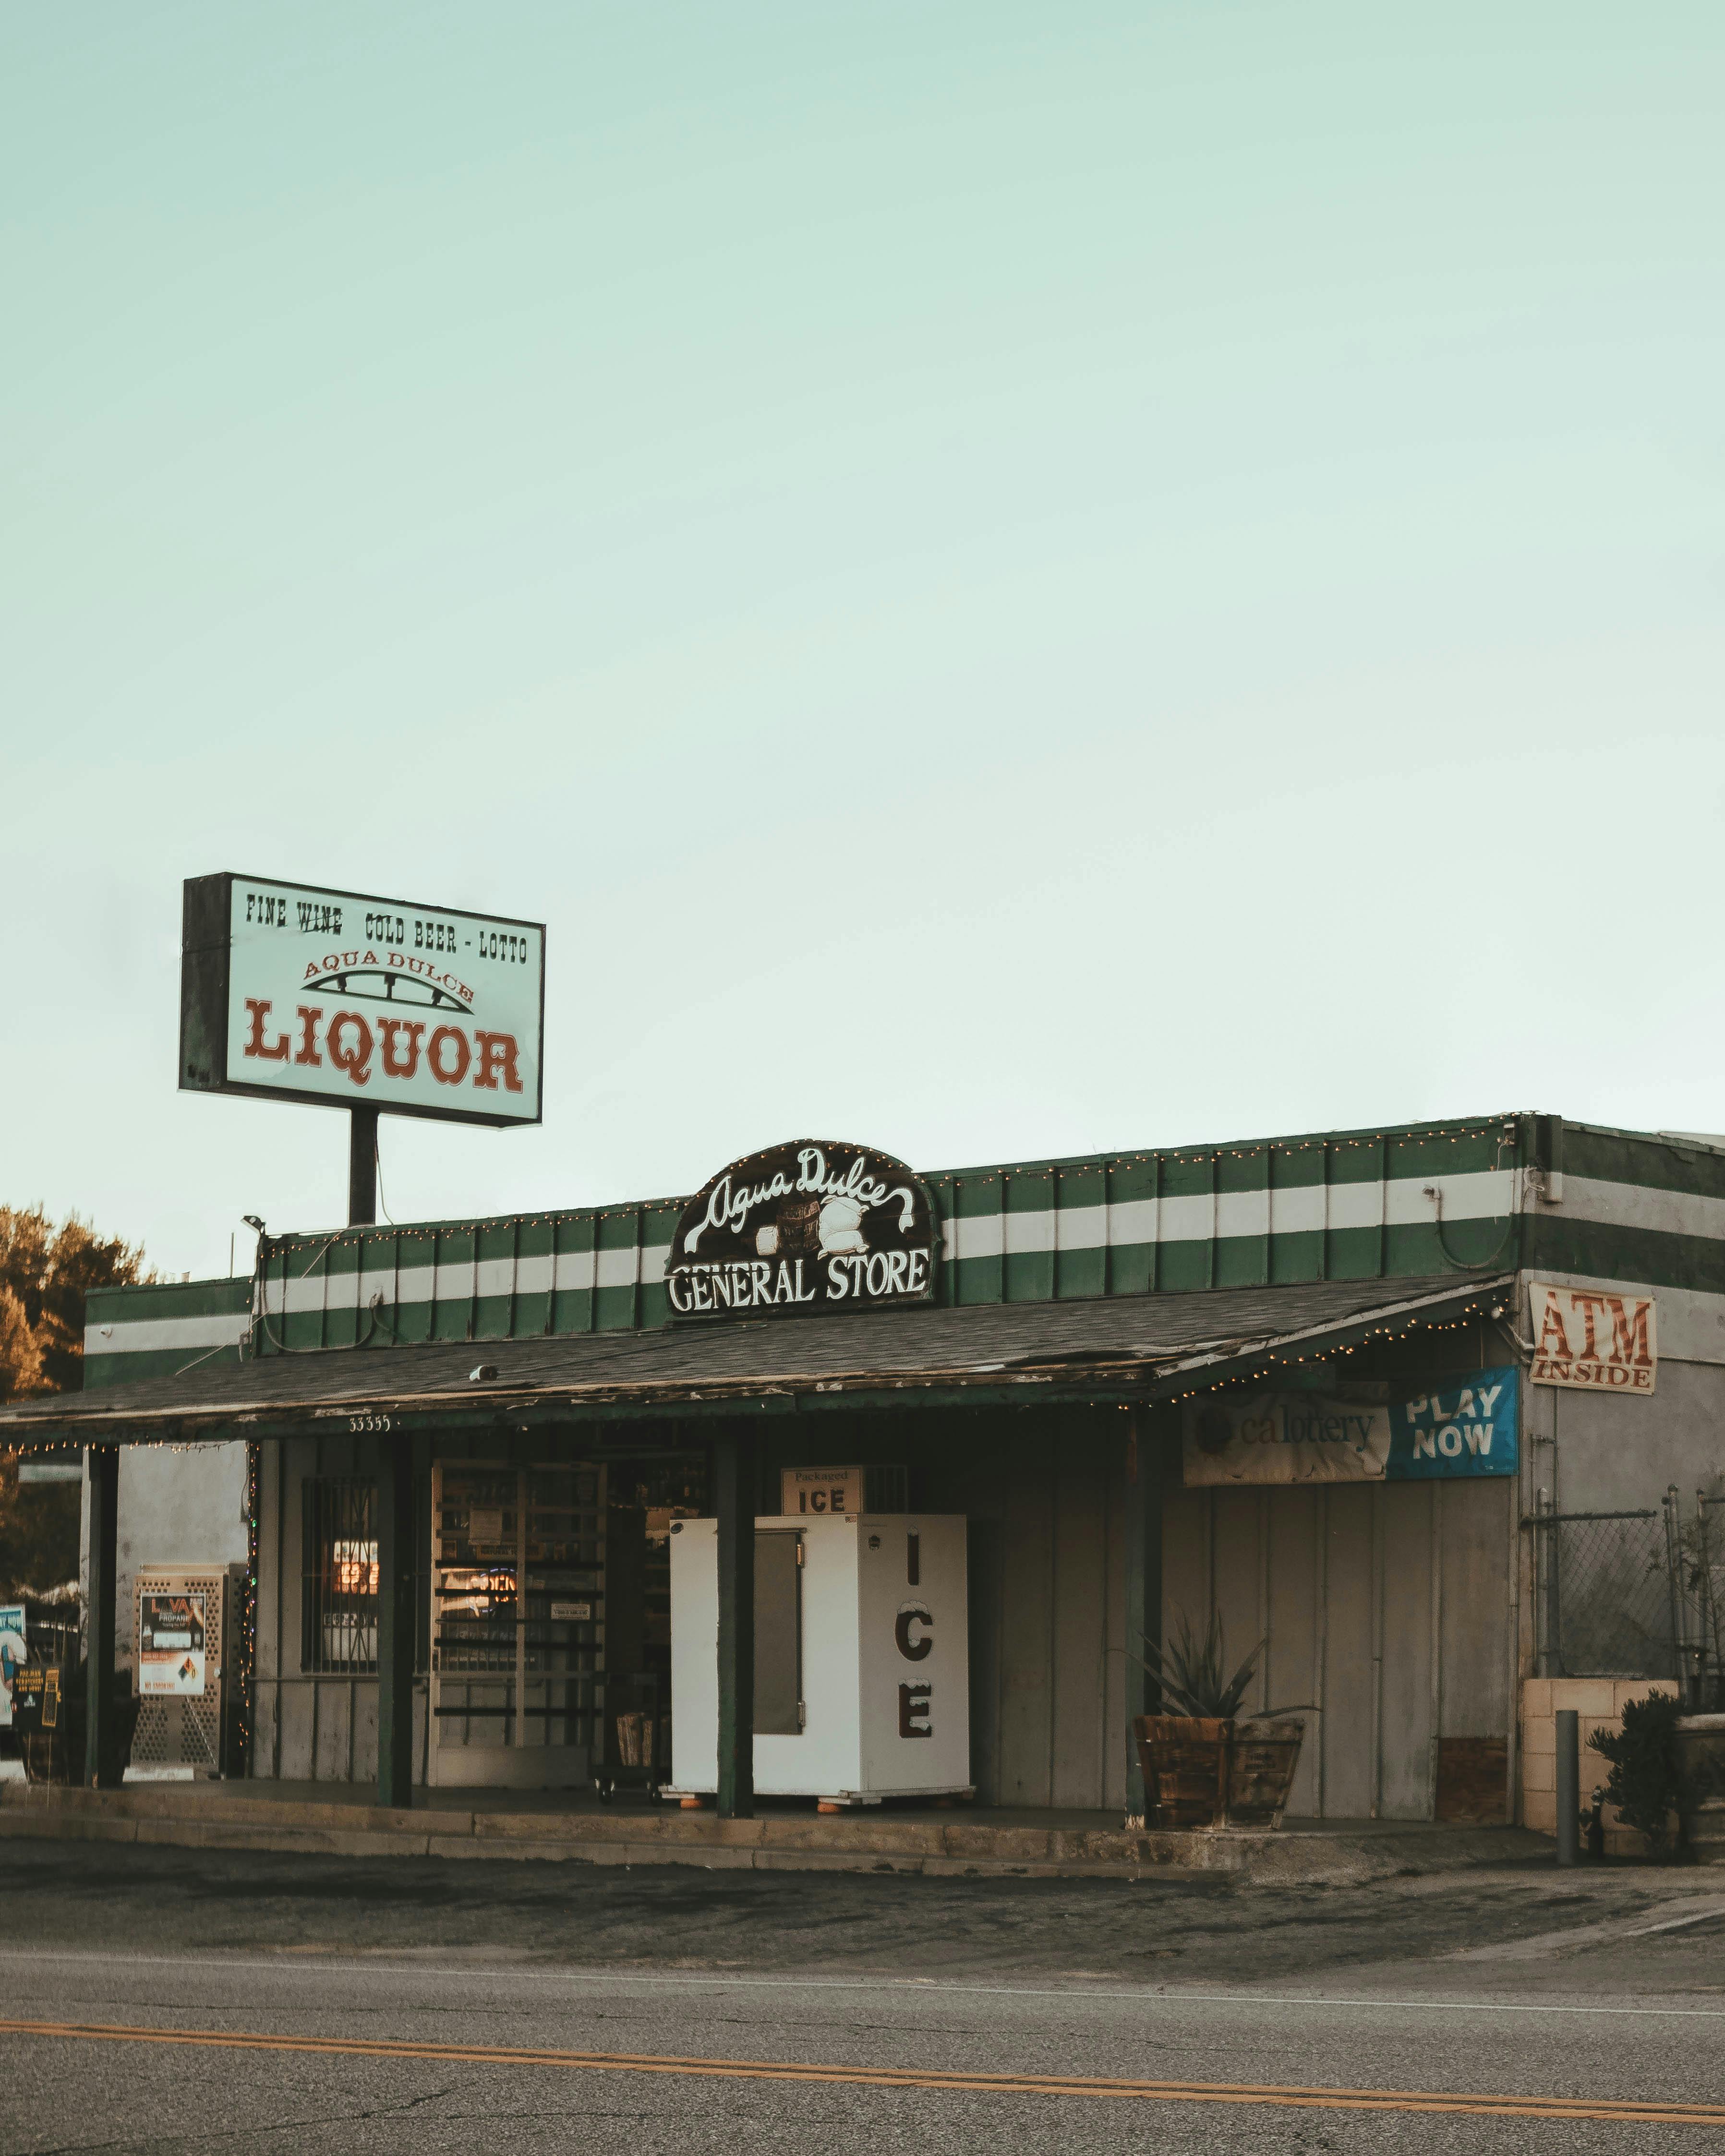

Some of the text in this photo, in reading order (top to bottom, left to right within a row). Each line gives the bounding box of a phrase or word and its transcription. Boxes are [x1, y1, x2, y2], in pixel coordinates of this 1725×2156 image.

[246, 894, 288, 927] FINE
[296, 902, 343, 936] WINE
[365, 912, 404, 945] COLD
[414, 920, 457, 953] BEER
[479, 931, 528, 964] LOTTO
[303, 950, 475, 1004] AQUA DULCE
[242, 998, 524, 1094] LIQUOR
[684, 1148, 915, 1253] Agua Dulce
[669, 1249, 929, 1312] GENERAL STORE
[1536, 1291, 1651, 1367] ATM
[1532, 1361, 1652, 1388] INSIDE
[350, 1414, 390, 1433] 33355
[1405, 1385, 1503, 1424] PLAY
[1412, 1423, 1495, 1459] NOW
[795, 1470, 849, 1483] Packaged
[798, 1489, 845, 1513] ICE
[895, 1525, 933, 1738] ICE
[144, 1682, 176, 1691] NO SMOKING
